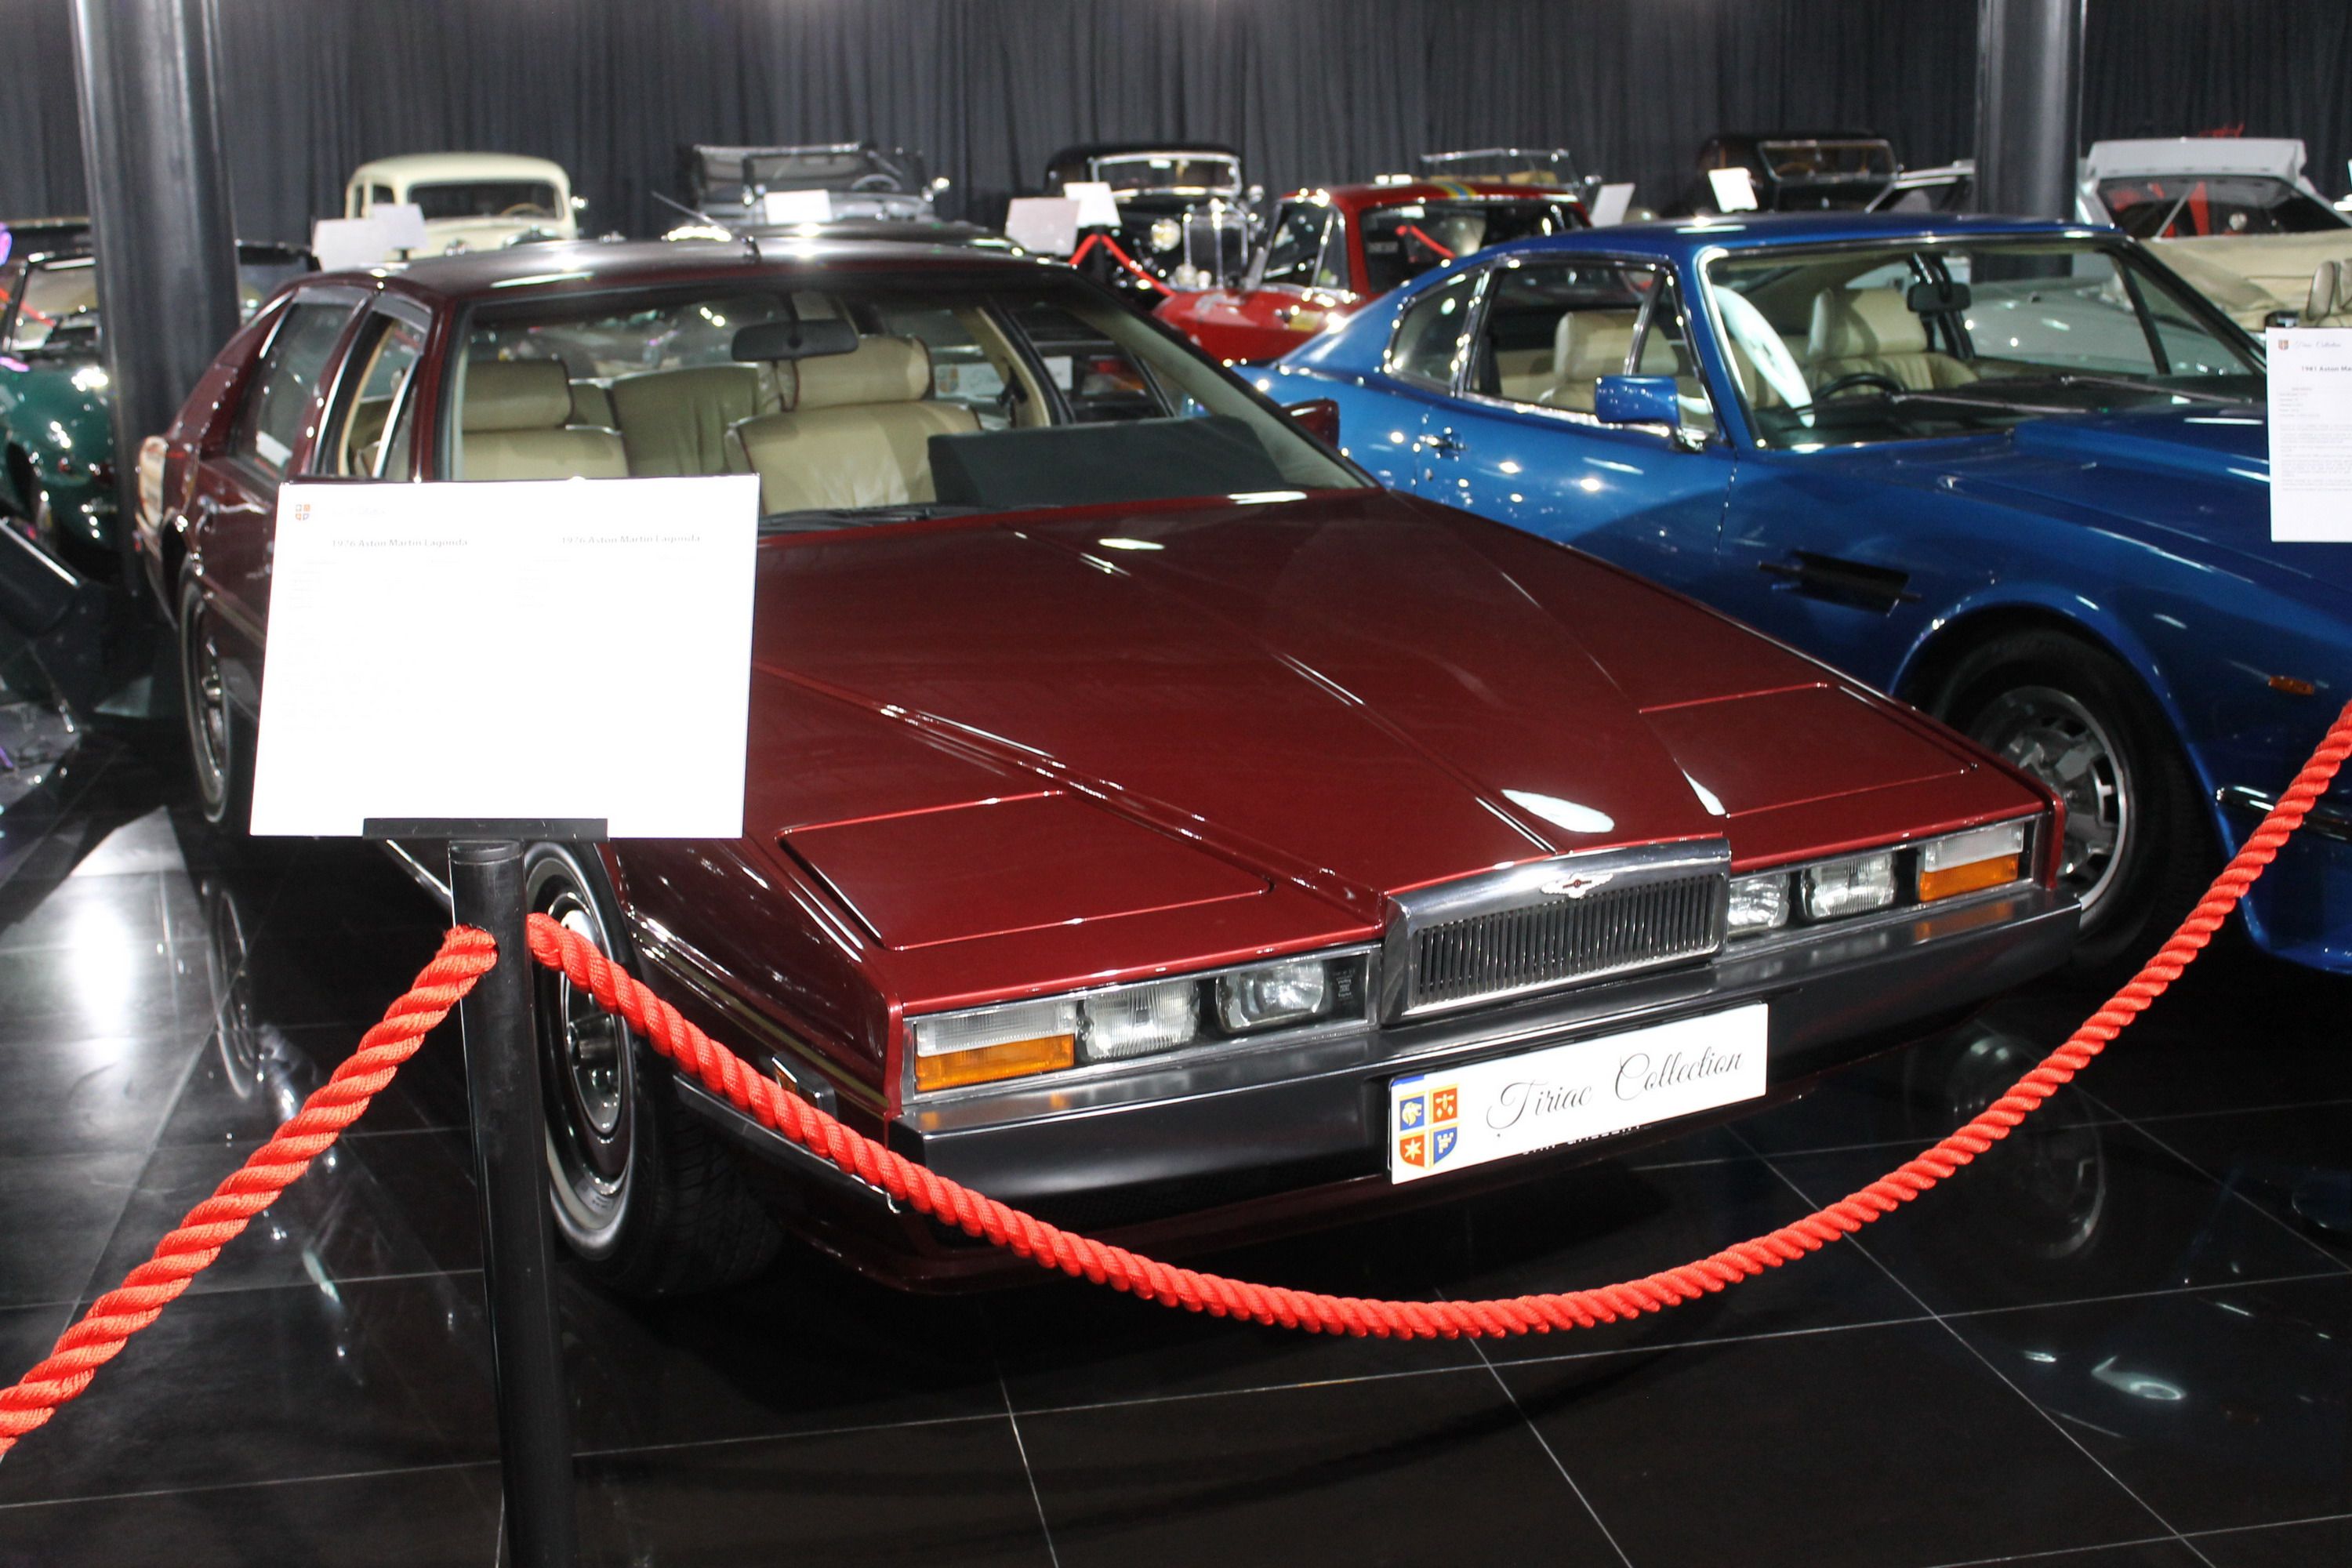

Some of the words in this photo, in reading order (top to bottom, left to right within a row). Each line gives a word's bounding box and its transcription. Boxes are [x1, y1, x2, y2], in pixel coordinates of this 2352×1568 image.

[424, 538, 468, 548] Lagonda
[620, 535, 652, 543] Martin
[1615, 1046, 1743, 1101] Collection
